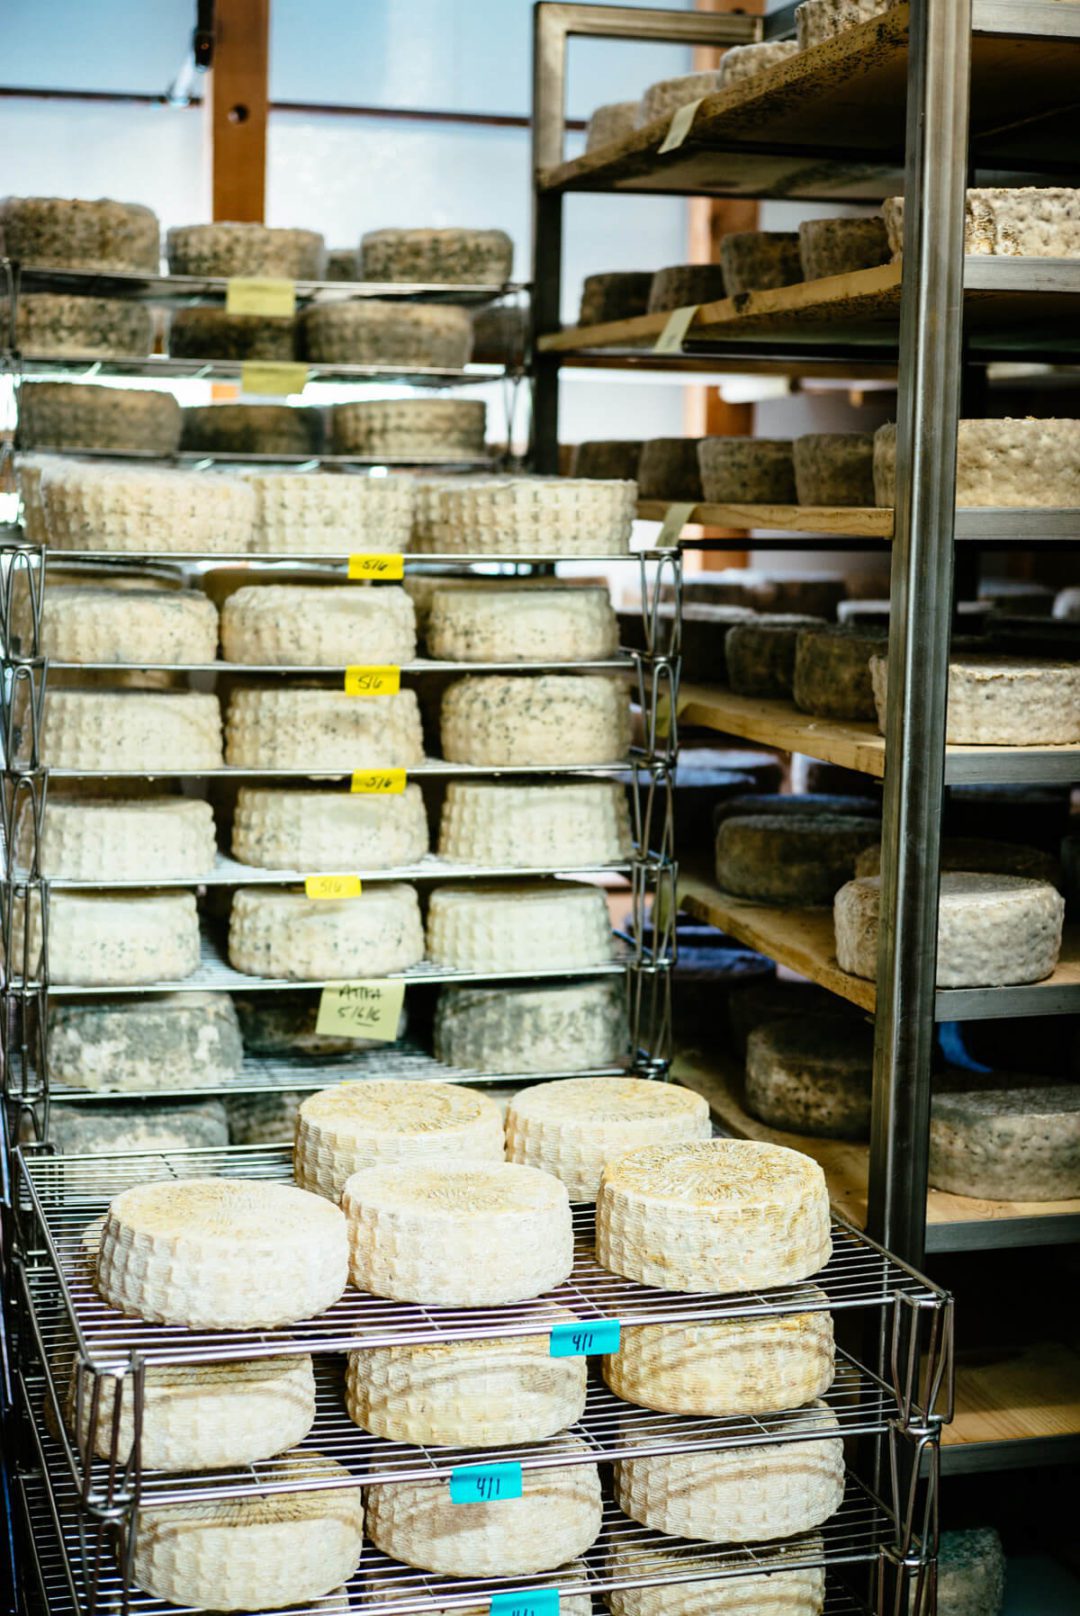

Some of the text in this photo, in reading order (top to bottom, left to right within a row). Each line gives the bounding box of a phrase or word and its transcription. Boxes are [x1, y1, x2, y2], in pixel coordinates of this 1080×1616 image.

[365, 775, 392, 789] 5/6
[572, 1333, 593, 1352] 4/1
[477, 1476, 500, 1499] 4/1
